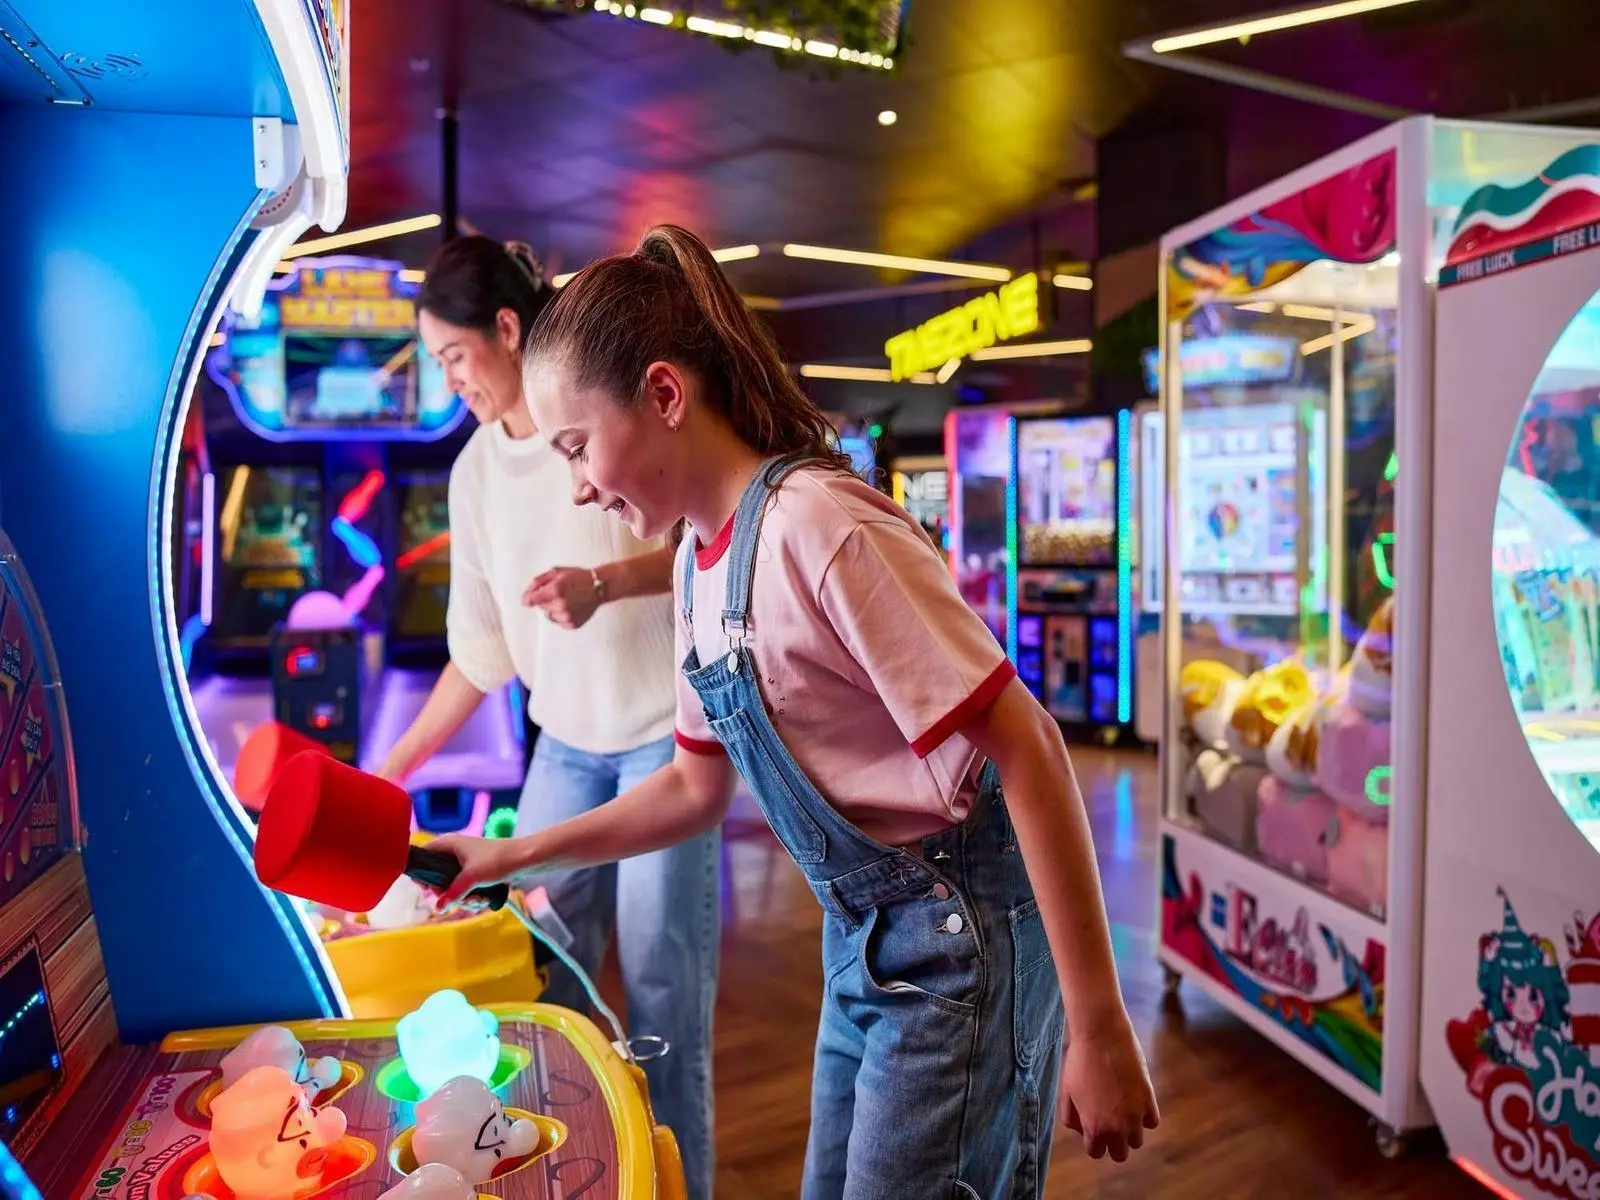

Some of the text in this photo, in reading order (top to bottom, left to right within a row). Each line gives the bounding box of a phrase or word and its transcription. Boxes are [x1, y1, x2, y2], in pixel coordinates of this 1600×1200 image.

[1553, 227, 1585, 256] FREE
[885, 272, 1038, 383] TIMEZONE
[127, 1134, 201, 1185] Values
